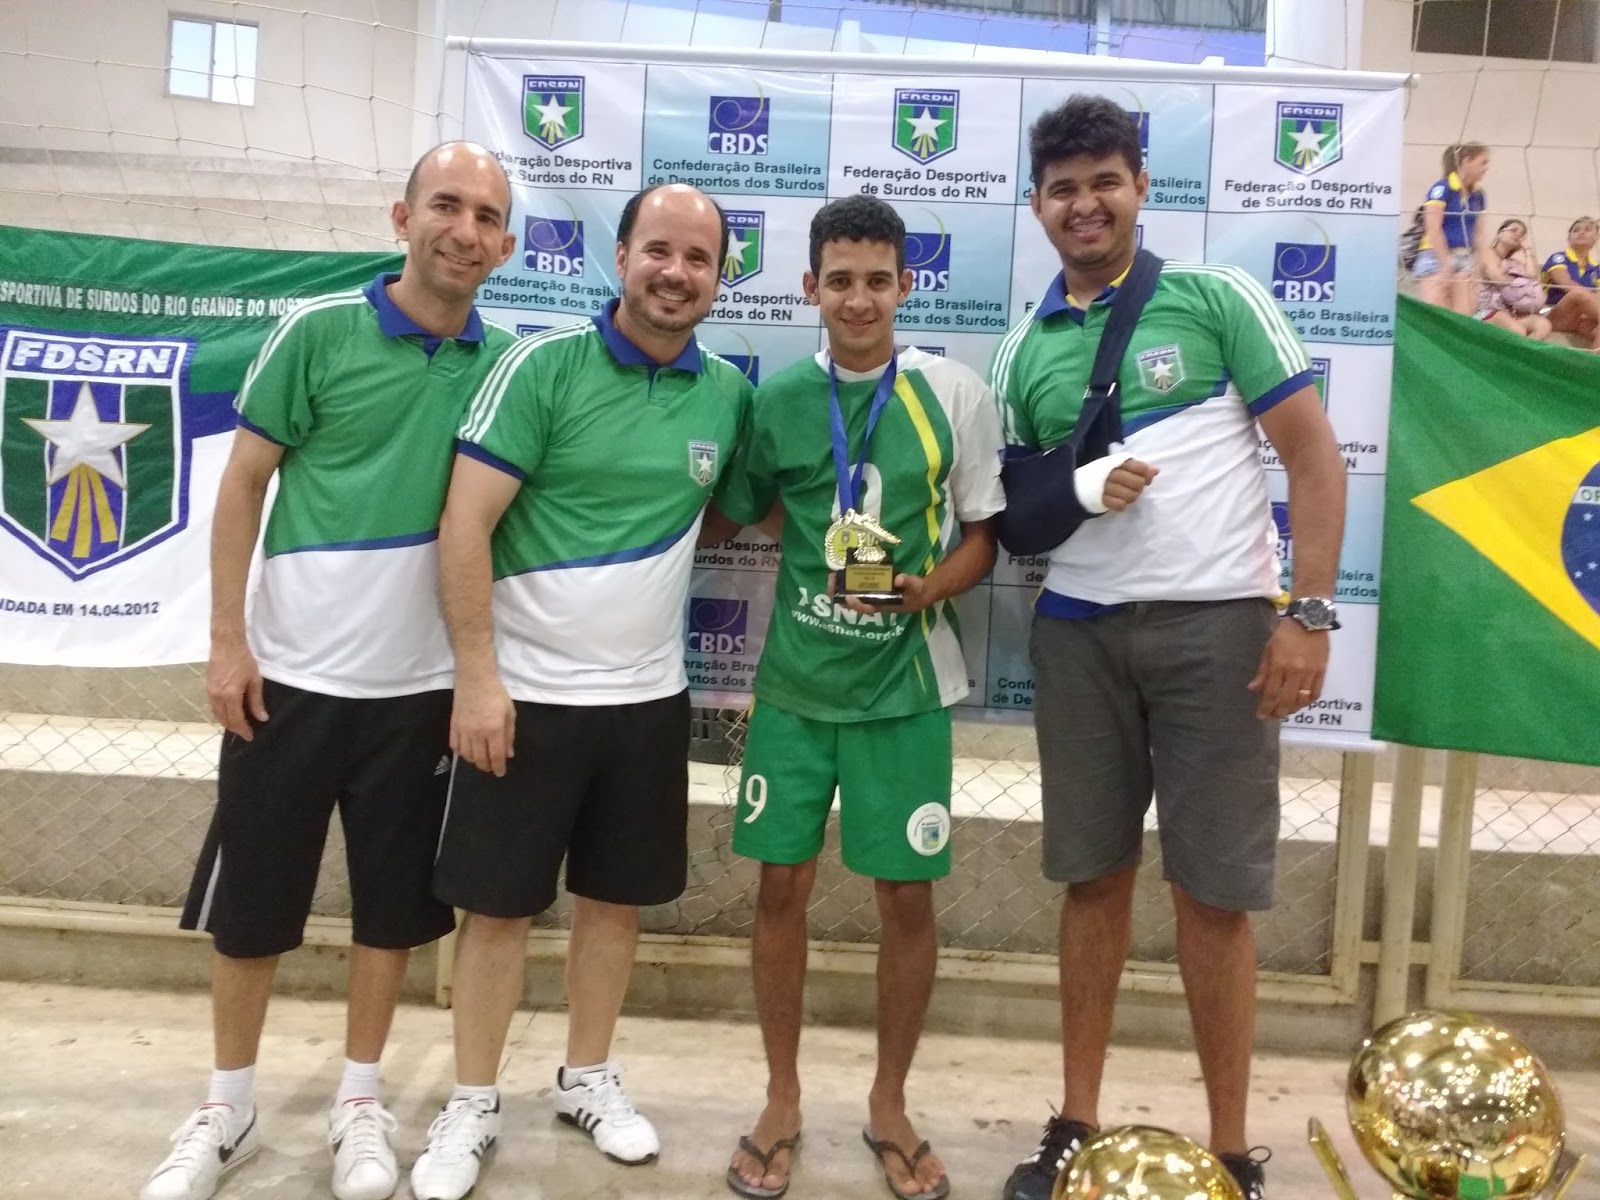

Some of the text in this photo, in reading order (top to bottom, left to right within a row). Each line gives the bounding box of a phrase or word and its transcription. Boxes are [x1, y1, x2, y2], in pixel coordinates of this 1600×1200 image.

[708, 132, 768, 155] CBDS
[491, 150, 633, 171] deração Desportiva
[652, 159, 822, 175] Confederação Brasileira
[517, 168, 566, 184] Surdos
[569, 172, 587, 184] do
[592, 173, 614, 185] RN
[668, 174, 740, 188] Desportos
[744, 177, 770, 189] dos
[774, 178, 826, 190] Surdos
[843, 165, 1007, 184] Federação Desportiva
[860, 182, 987, 199] de Surdos do RN
[1224, 179, 1392, 195] Federação Desportiva
[1153, 191, 1206, 206] Surdos
[1241, 194, 1373, 210] de Surdos do RN
[524, 249, 584, 277] CBDS
[483, 289, 556, 305] Desportos
[560, 297, 587, 310] dos
[733, 291, 811, 307] Desportiva
[1272, 280, 1335, 303] CBDS
[66, 287, 83, 309] DE
[86, 288, 139, 314] SURDOS
[142, 293, 160, 315] DO
[164, 295, 188, 316] RIO
[191, 297, 244, 317] GRANDE
[247, 298, 266, 317] DO
[934, 298, 1002, 312] Brasileira
[747, 308, 767, 320] do
[771, 309, 793, 321] RN
[928, 313, 950, 326] dos
[955, 315, 1006, 328] Surdos
[1320, 308, 1389, 323] Brasileira
[1310, 323, 1336, 337] dos
[1340, 325, 1393, 339] Surdos
[12, 339, 172, 374] FDSRN
[723, 539, 782, 553] Desport
[739, 554, 757, 567] do
[1025, 571, 1043, 583] de
[53, 603, 73, 616] EM
[80, 602, 160, 617] 14.04.2012
[687, 632, 746, 655] CBDS
[721, 675, 747, 687] dos
[992, 692, 1009, 703] de
[1294, 713, 1314, 725] do
[1319, 713, 1343, 726] RN
[743, 773, 768, 824] 9
